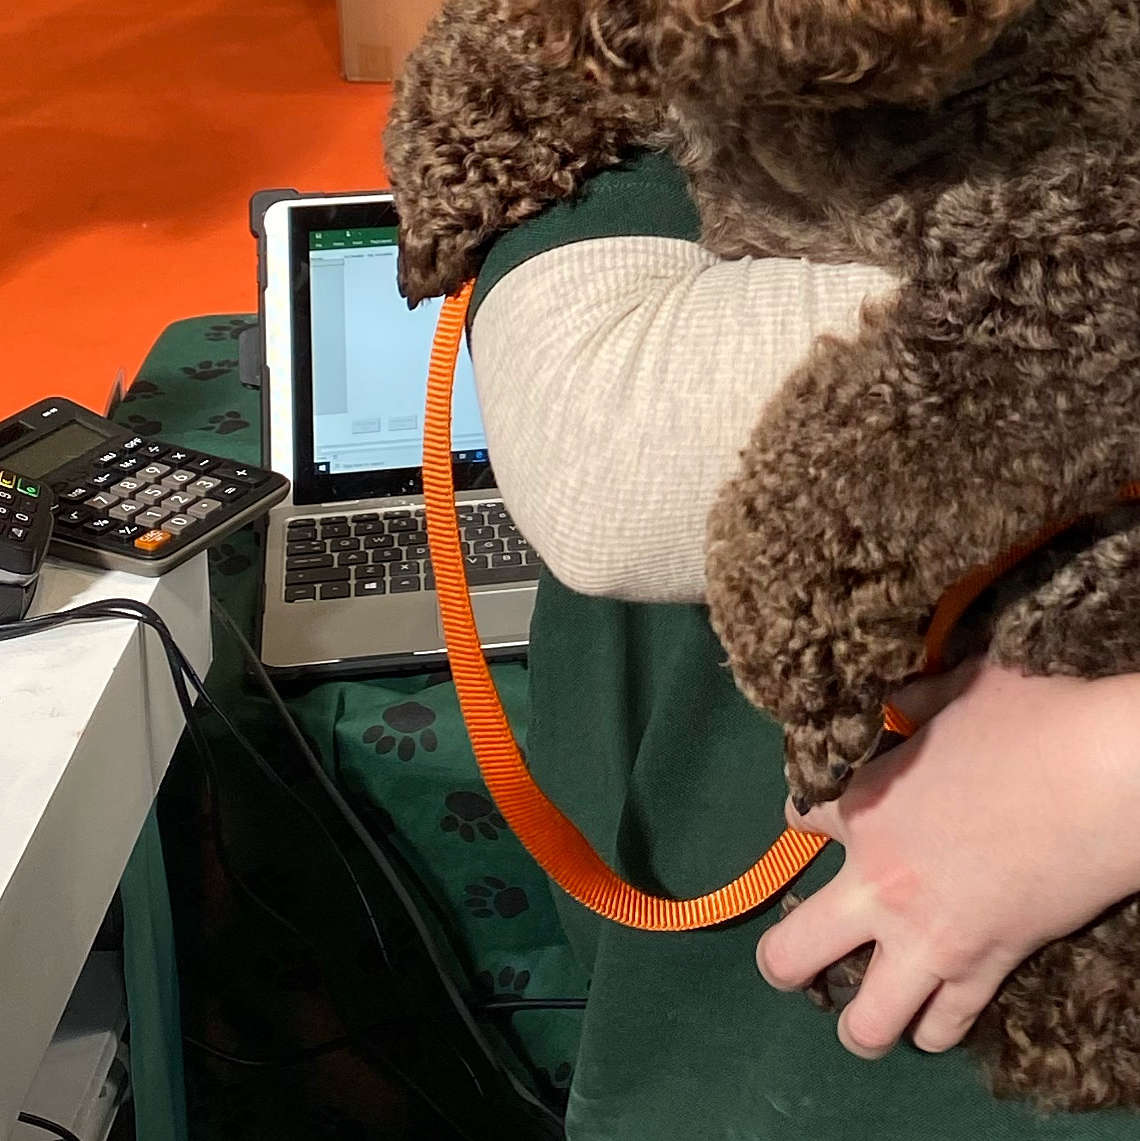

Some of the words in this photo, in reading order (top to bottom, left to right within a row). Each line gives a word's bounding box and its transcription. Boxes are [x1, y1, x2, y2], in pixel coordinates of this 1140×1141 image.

[93, 496, 108, 505] 7
[120, 481, 137, 489] 8
[145, 466, 161, 474] 9
[171, 495, 189, 504] 2
[196, 480, 214, 489] 3
[121, 503, 137, 511] 4
[145, 488, 162, 496] 5
[171, 517, 188, 526] 0
